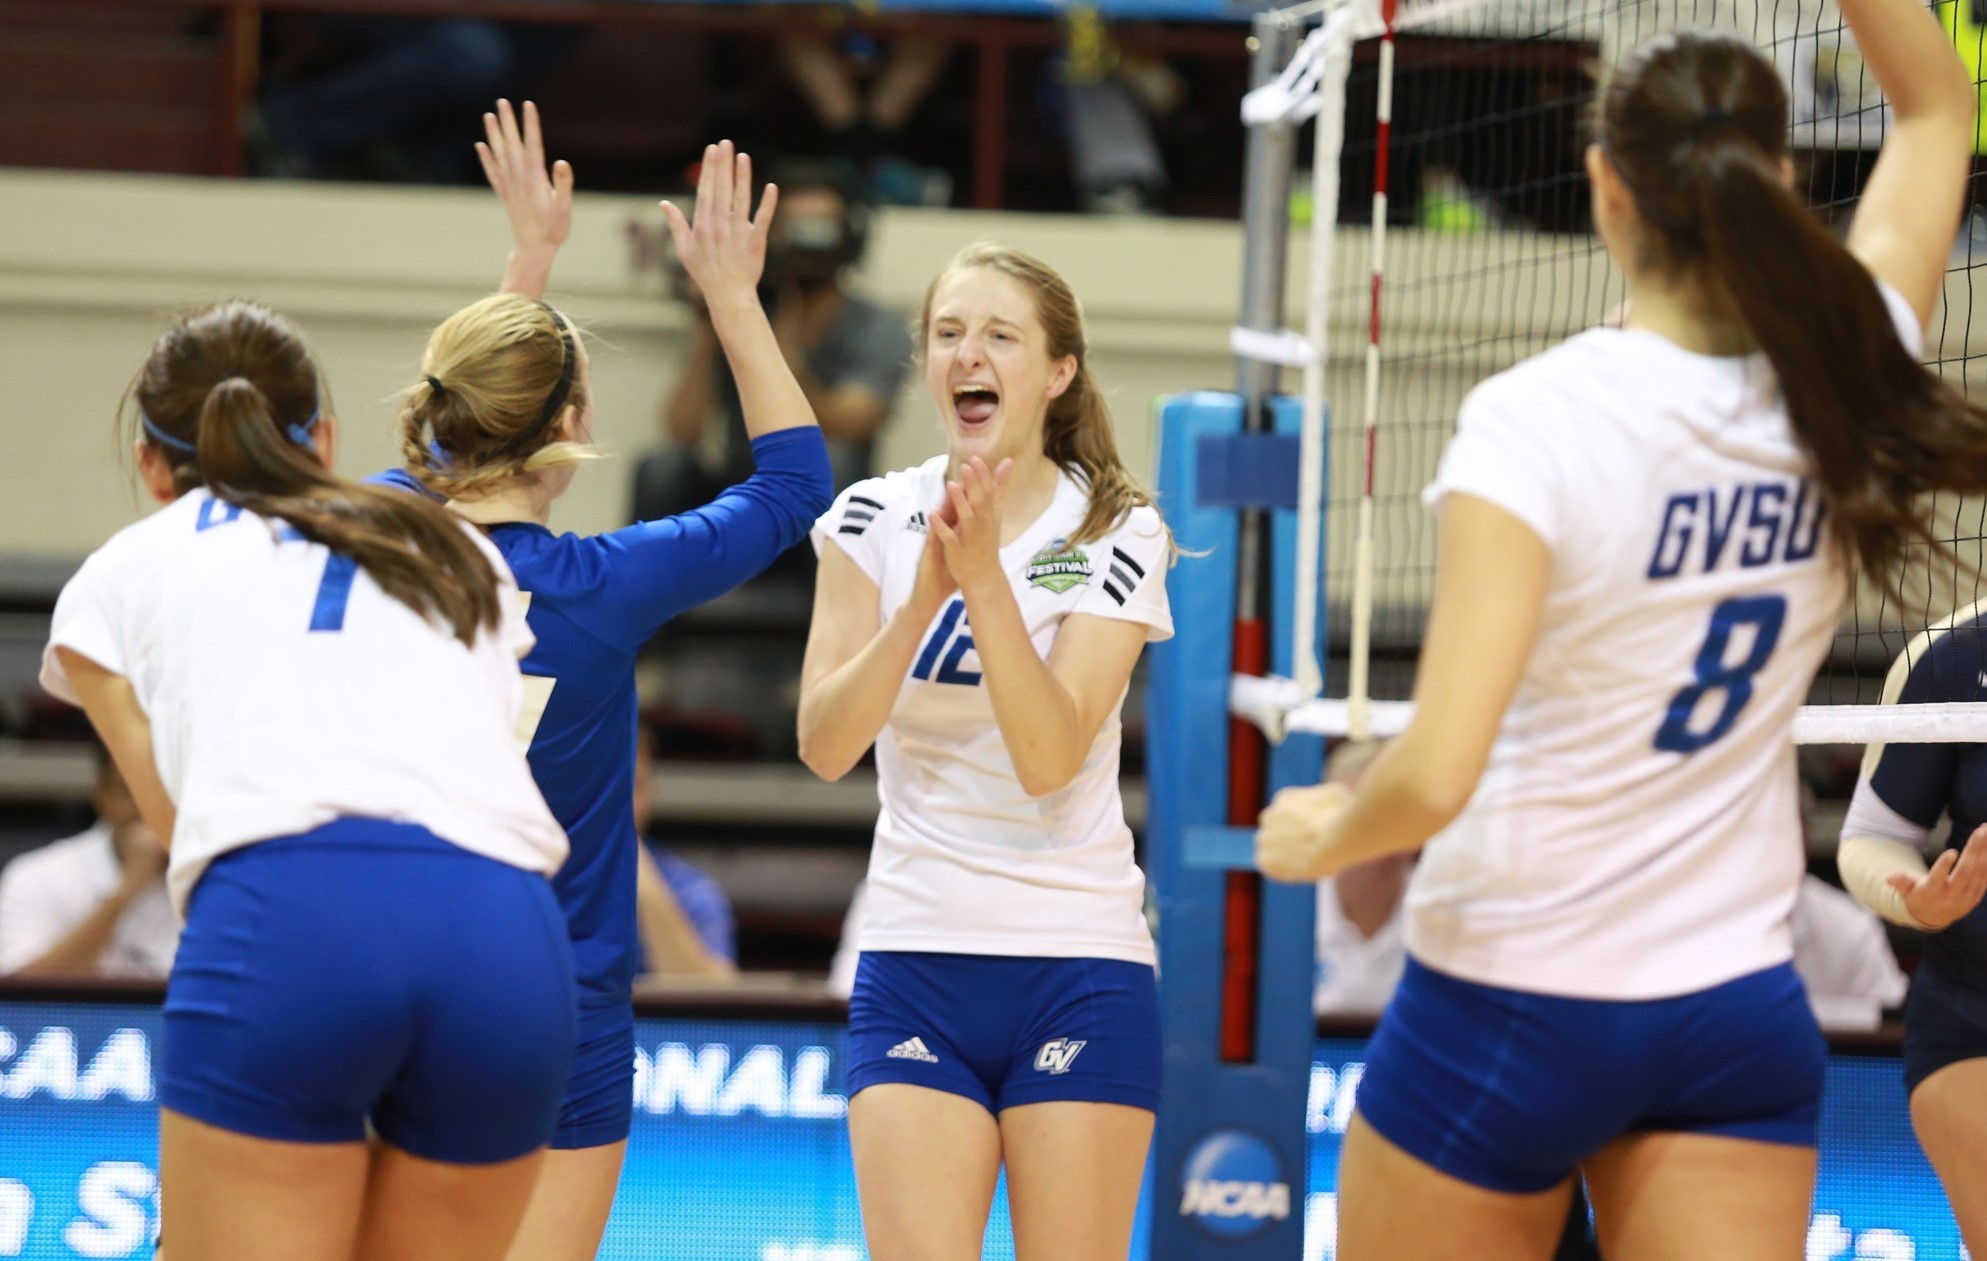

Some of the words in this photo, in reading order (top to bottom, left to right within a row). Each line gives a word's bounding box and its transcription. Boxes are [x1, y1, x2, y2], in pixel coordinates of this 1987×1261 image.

[1646, 478, 1828, 580] GVSU
[1026, 561, 1093, 579] FESTIVAL
[912, 599, 983, 687] 12
[1652, 594, 1788, 754] 8
[0, 1026, 156, 1101] AA
[633, 1042, 849, 1118] NAL
[886, 1049, 939, 1063] adidas
[1033, 1037, 1088, 1075] GV
[1178, 1178, 1291, 1222] NCAA
